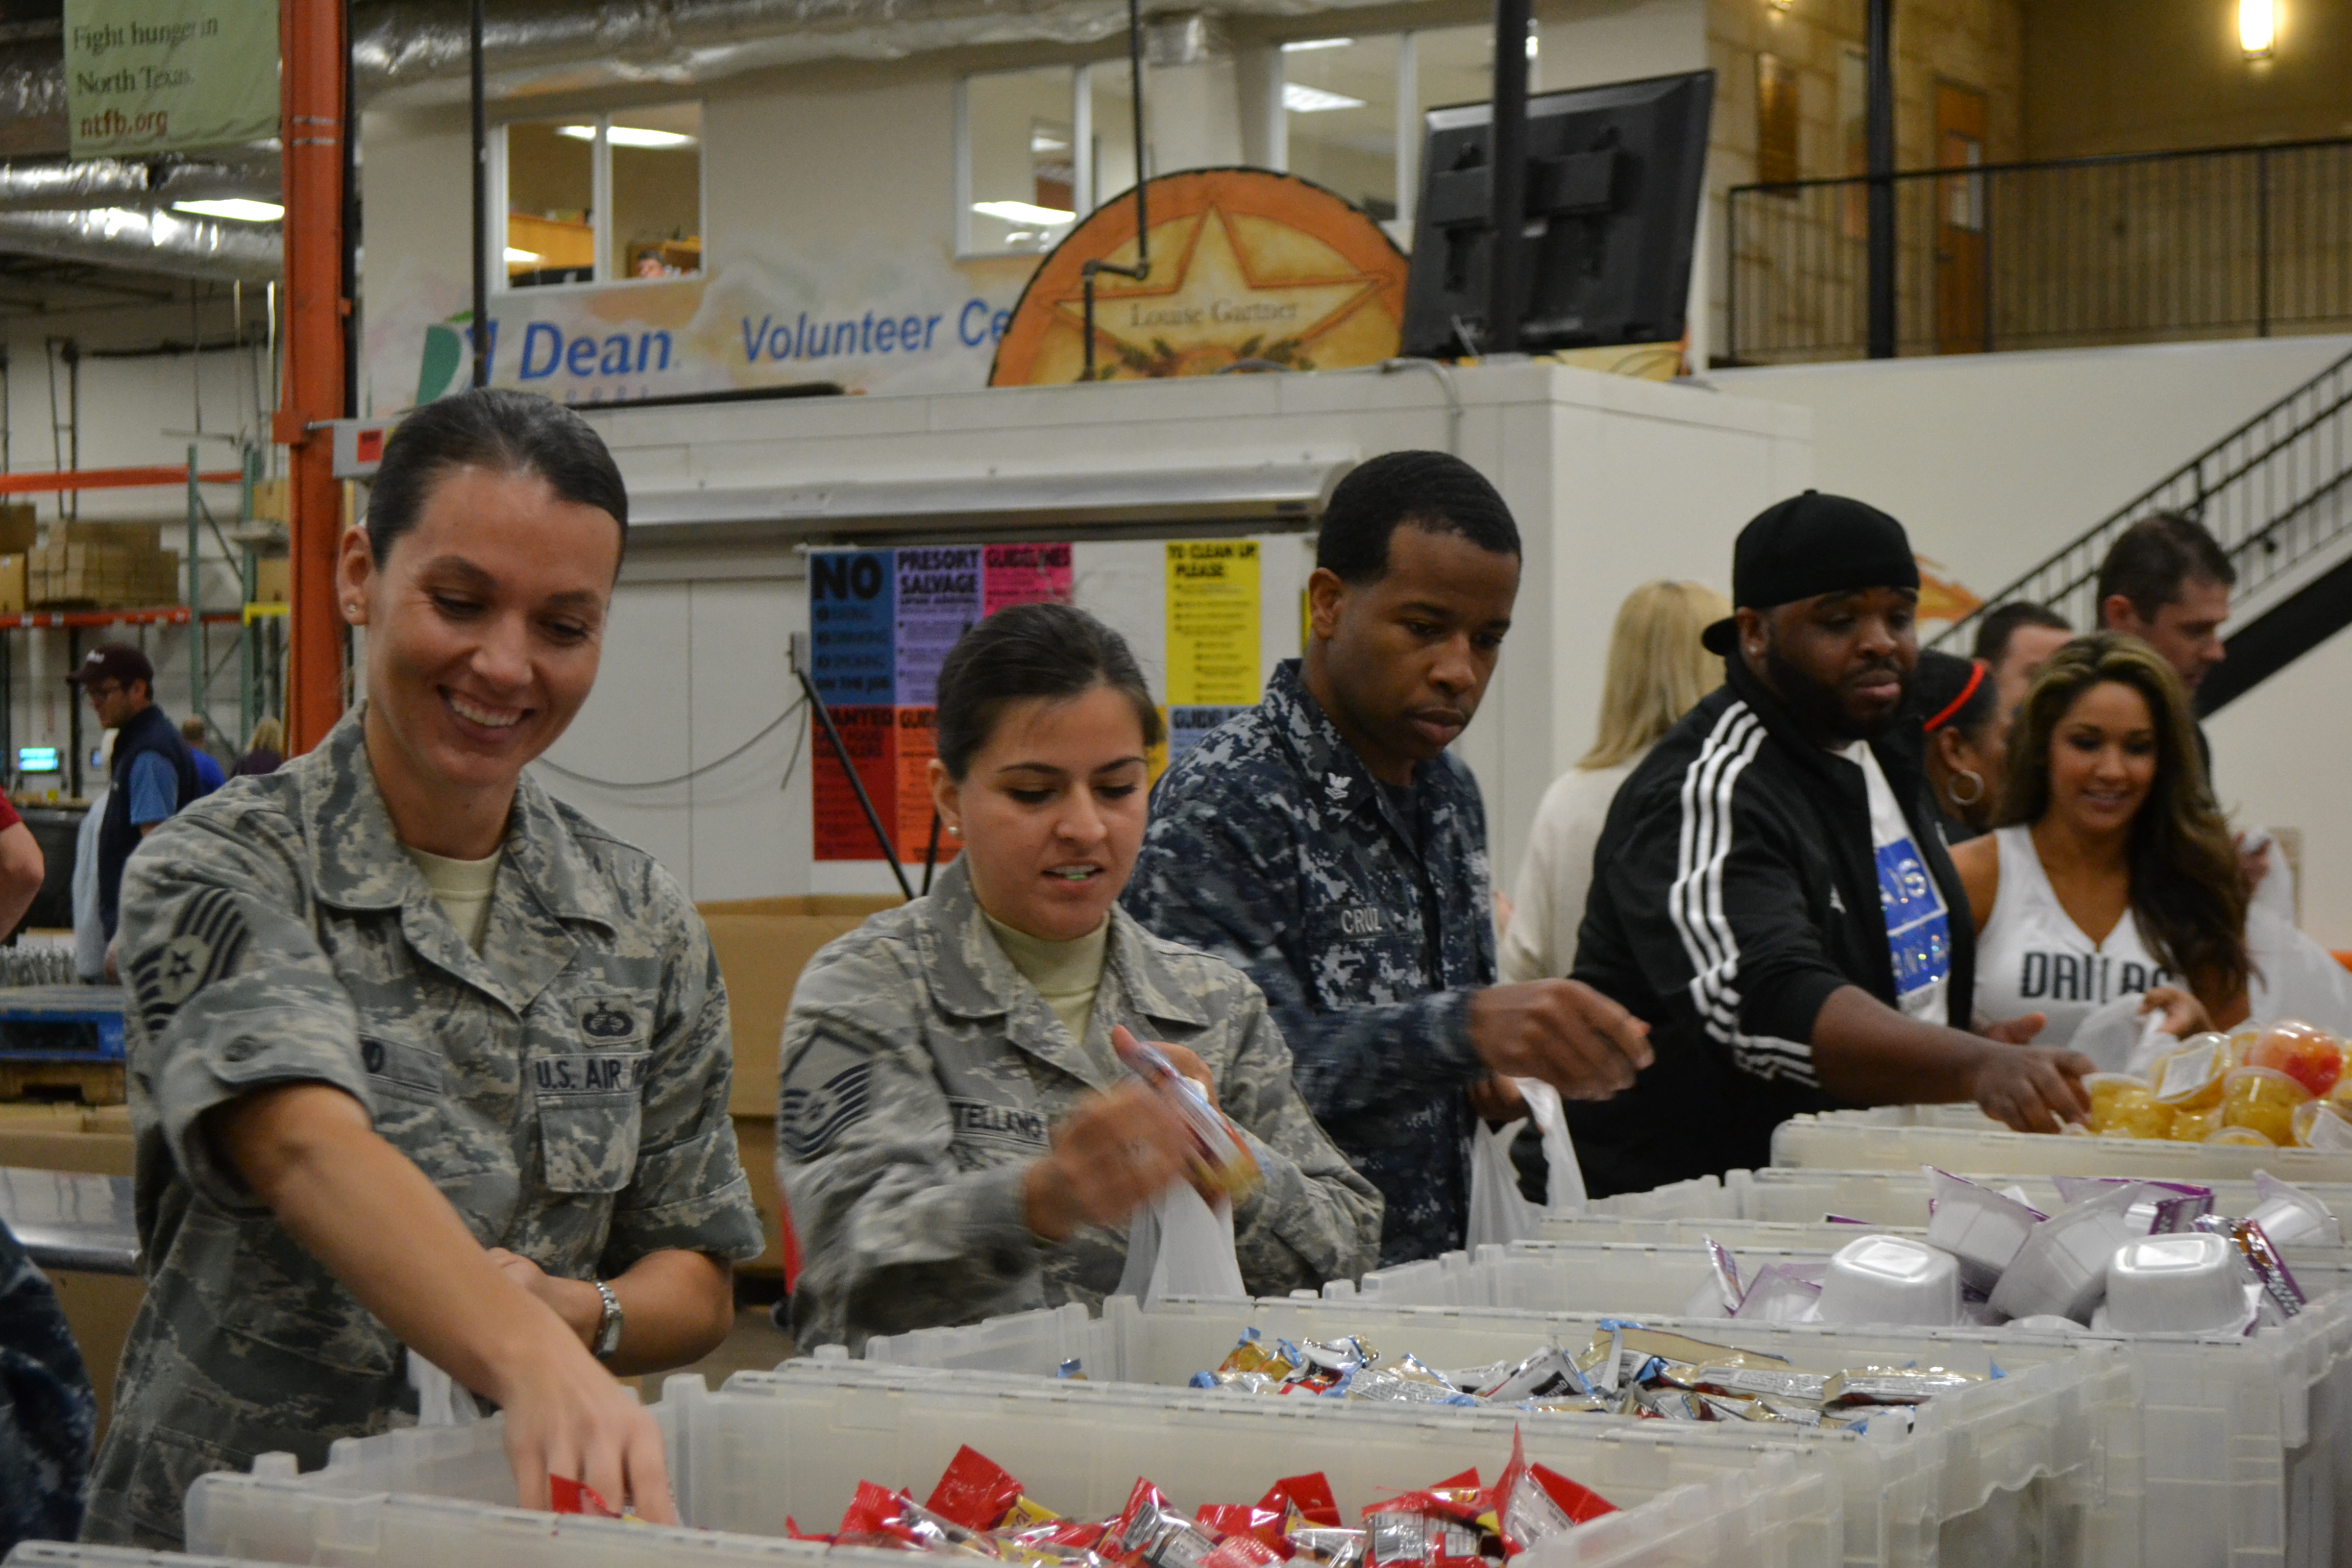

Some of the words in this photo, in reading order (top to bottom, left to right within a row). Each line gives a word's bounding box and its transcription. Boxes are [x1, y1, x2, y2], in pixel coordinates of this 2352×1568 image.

[73, 23, 124, 56] Fight
[130, 21, 197, 50] hunger
[200, 17, 218, 38] in
[77, 67, 136, 96] North
[81, 108, 168, 138] ntfb.org
[519, 321, 673, 381] Dean
[741, 309, 944, 363] Volunteer
[813, 554, 883, 601] NO
[536, 1060, 576, 1089] U.S.
[587, 1058, 621, 1089] AIR
